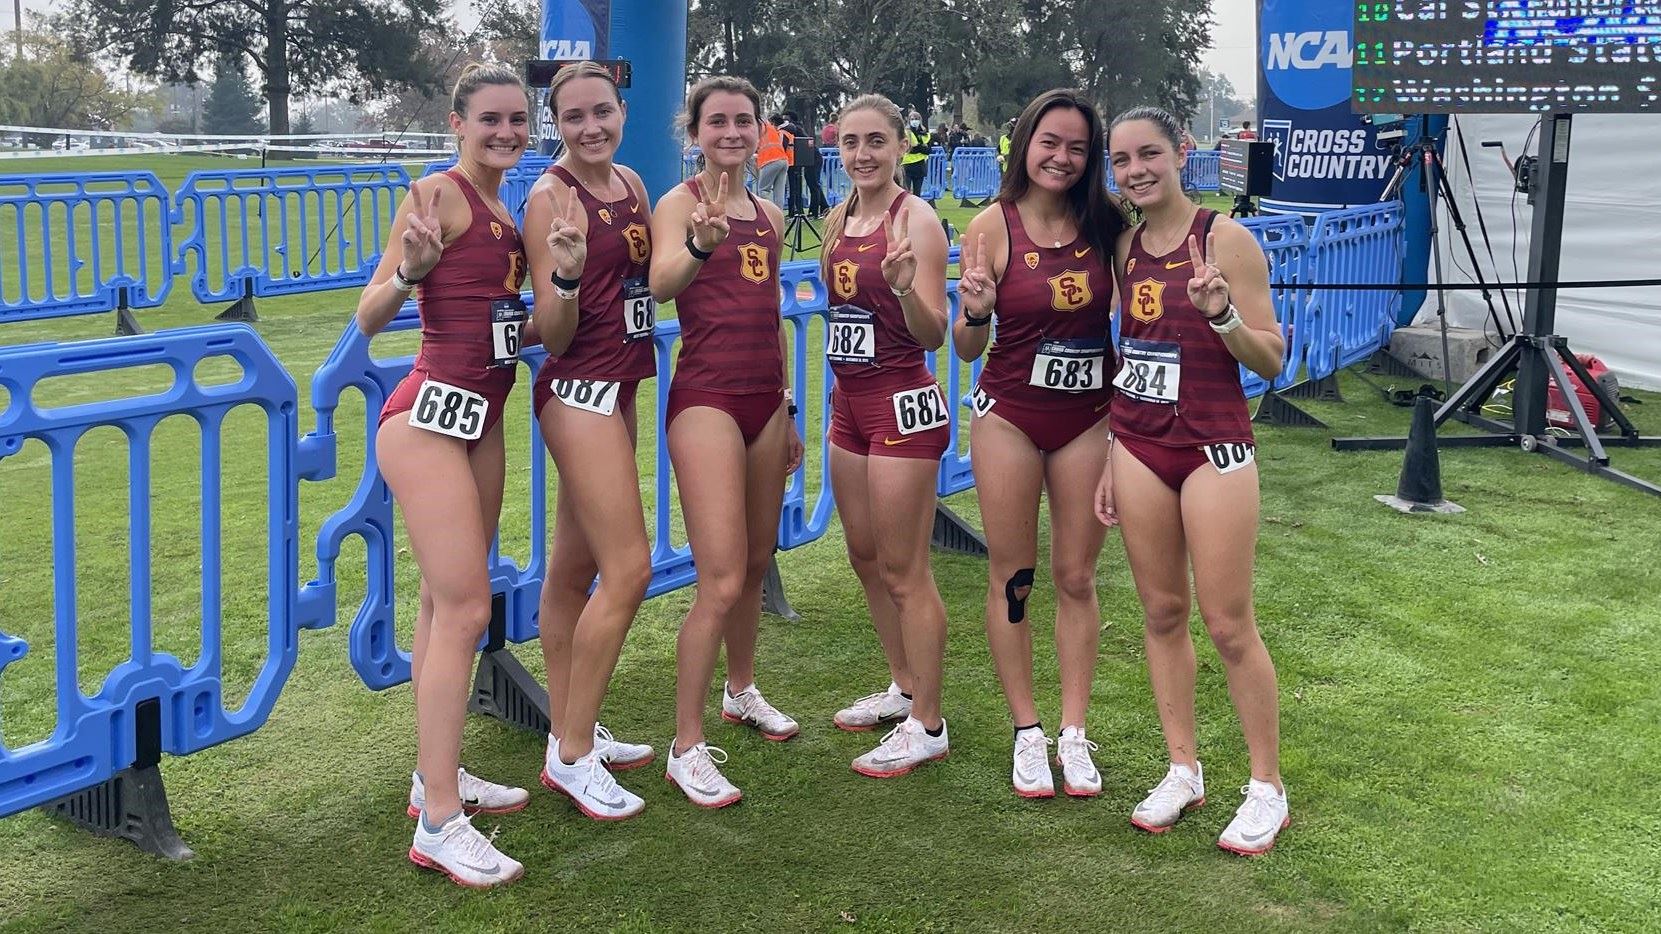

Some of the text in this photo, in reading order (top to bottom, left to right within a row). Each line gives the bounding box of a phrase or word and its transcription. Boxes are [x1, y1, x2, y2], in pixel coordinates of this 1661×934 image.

[1267, 31, 1353, 70] NCA
[1357, 43, 1386, 64] 11
[1393, 36, 1551, 64] Portland
[1290, 129, 1366, 154] CROSS
[1287, 154, 1392, 179] COUNTRY
[746, 248, 763, 277] SC
[839, 265, 852, 293] SC
[1060, 277, 1083, 305] SC
[1138, 285, 1155, 315] SC
[832, 325, 866, 355] 682
[1045, 358, 1094, 389] 683
[416, 385, 485, 435] 685
[899, 388, 947, 430] 682
